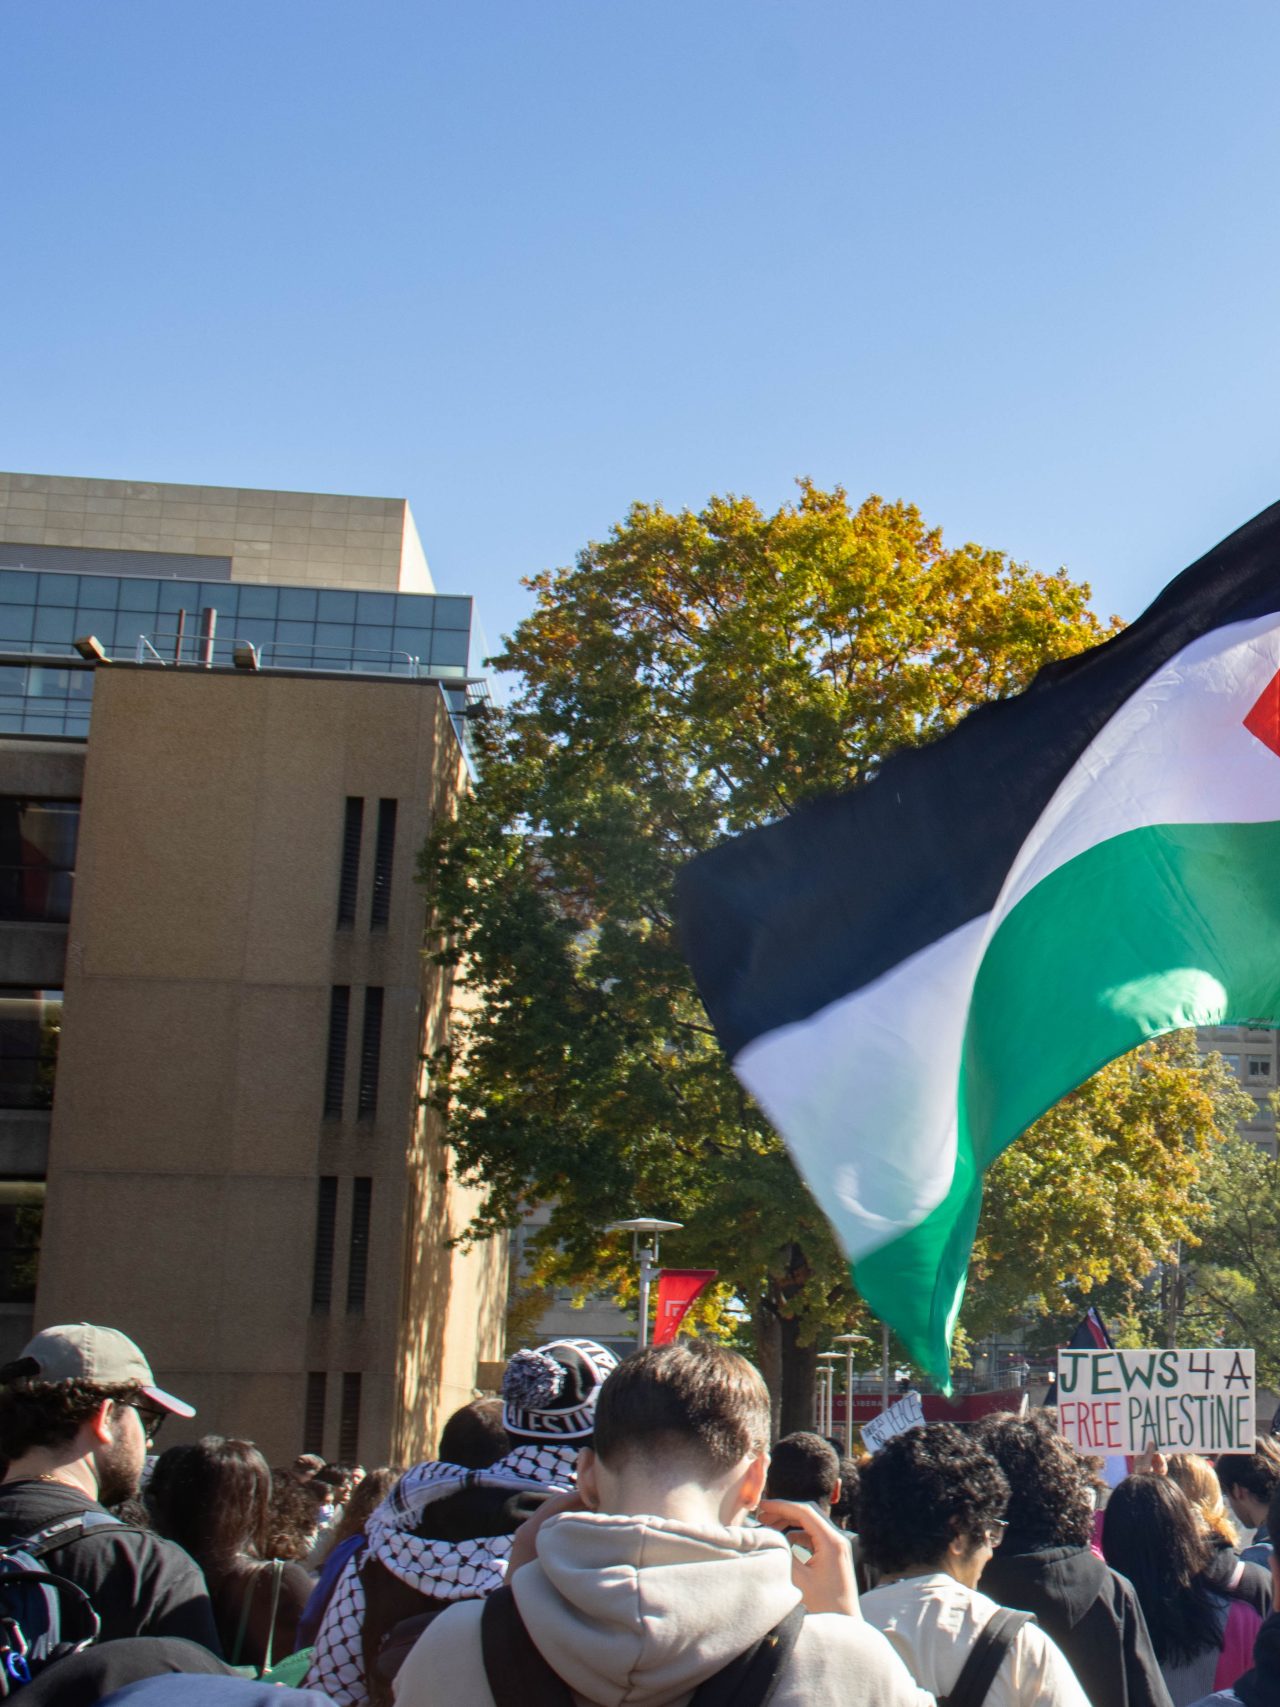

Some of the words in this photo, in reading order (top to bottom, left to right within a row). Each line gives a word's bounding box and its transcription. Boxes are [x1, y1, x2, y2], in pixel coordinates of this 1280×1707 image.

[1059, 1351, 1179, 1395] JEWS
[1188, 1352, 1215, 1390] 4
[1223, 1351, 1252, 1390] A
[1060, 1402, 1122, 1448] FREE
